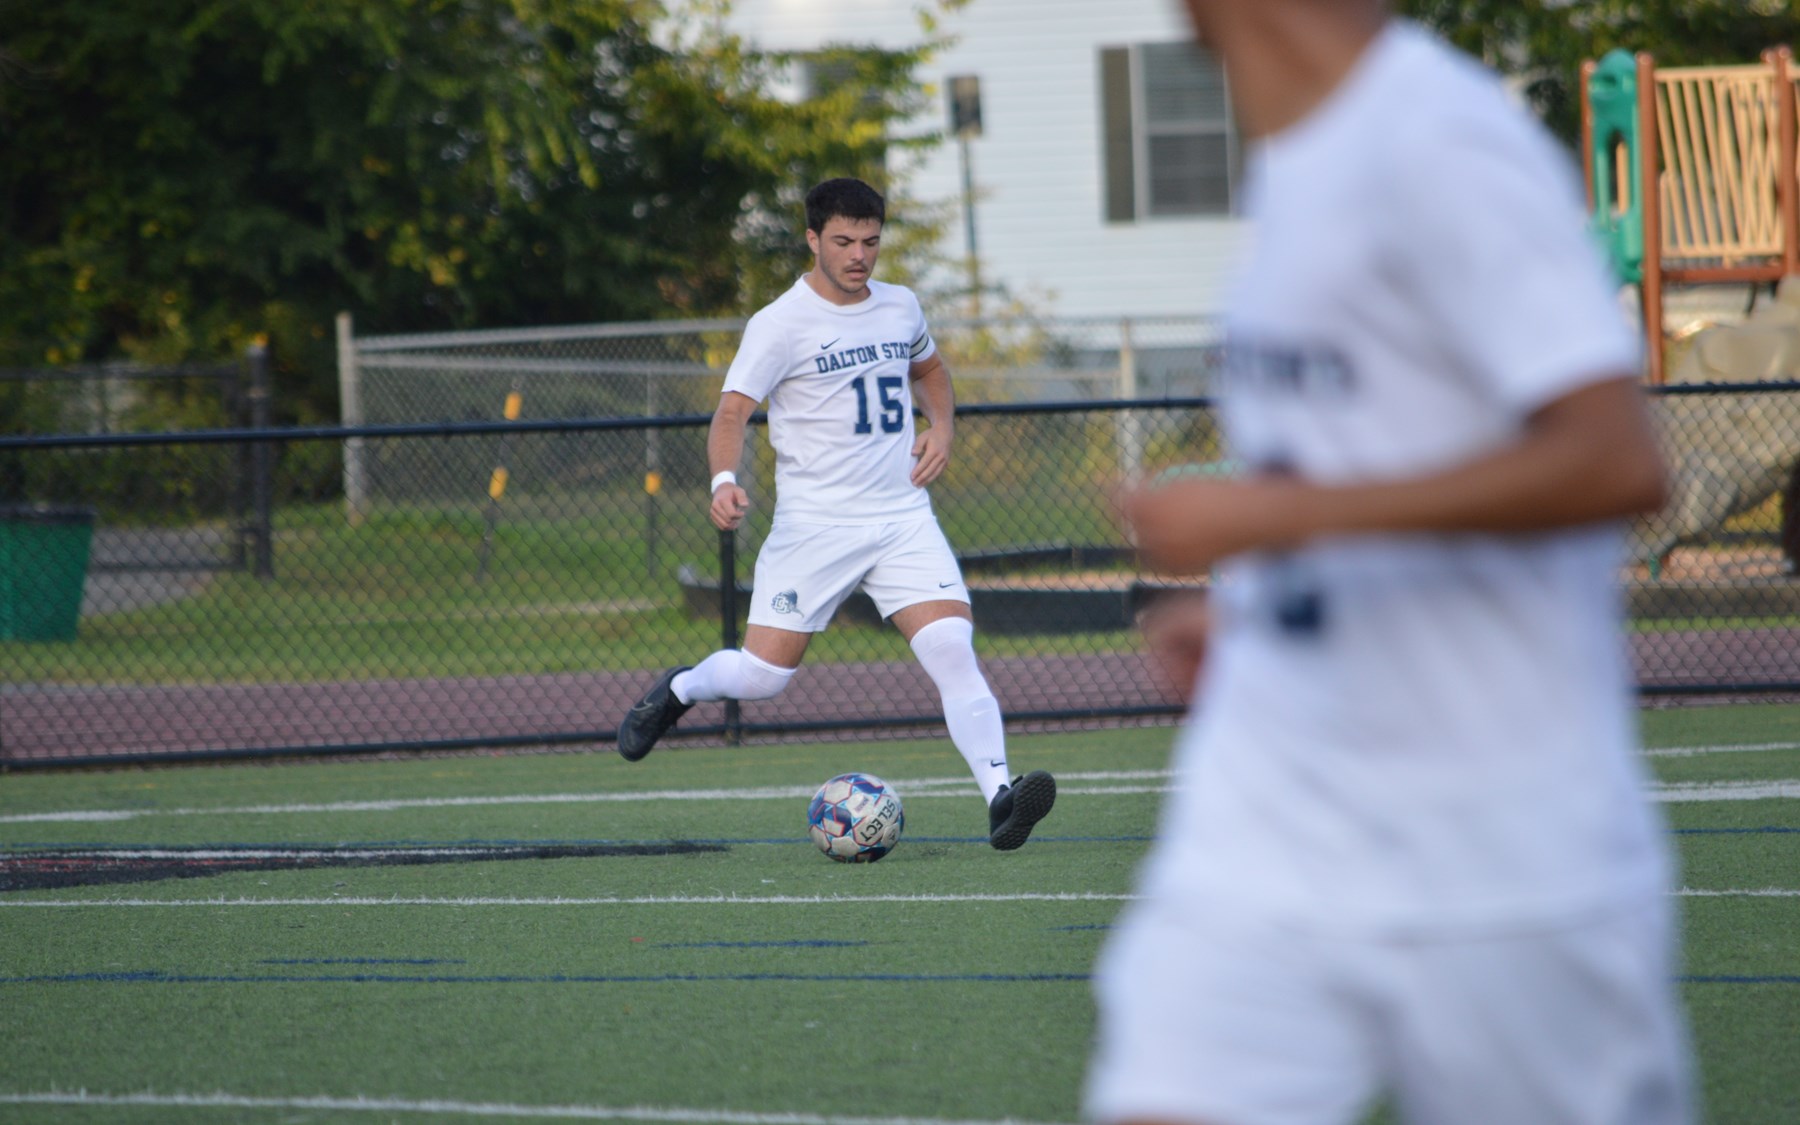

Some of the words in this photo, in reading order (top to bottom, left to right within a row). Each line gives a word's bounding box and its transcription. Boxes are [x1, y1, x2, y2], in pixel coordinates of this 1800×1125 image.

[815, 345, 879, 374] DALTON
[851, 376, 904, 434] 15
[860, 799, 896, 842] SELECT
